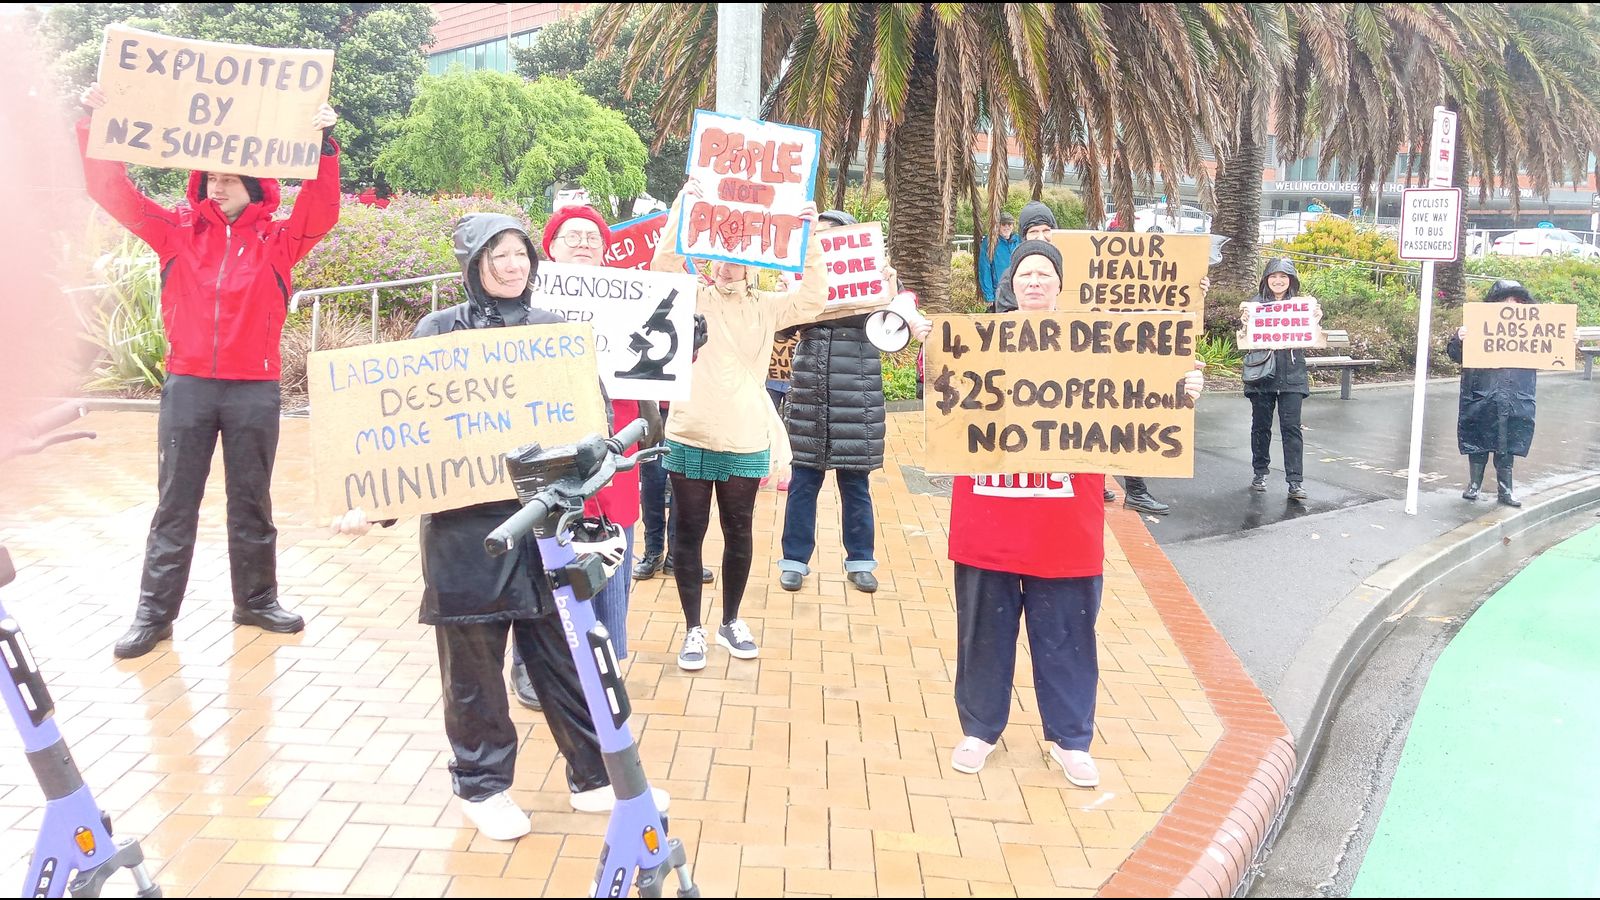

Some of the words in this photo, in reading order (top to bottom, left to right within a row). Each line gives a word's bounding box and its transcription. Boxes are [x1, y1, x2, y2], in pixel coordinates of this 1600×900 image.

[118, 39, 324, 91] EXPLOITED
[188, 92, 234, 126] BY
[105, 117, 153, 150] NZ
[698, 127, 804, 184] PEOPLE
[722, 179, 768, 203] NOT
[1275, 181, 1336, 192] WELLINGTON
[1412, 198, 1449, 208] CYCLISTS
[1411, 213, 1429, 222] GIVE
[1432, 213, 1448, 222] WAY
[687, 201, 804, 259] PROFIT
[1415, 226, 1424, 236] TO
[1427, 226, 1444, 236] BUS
[1089, 234, 1165, 258] YOUR
[1403, 240, 1453, 250] PASSENGERS
[1089, 258, 1177, 282] HEALTH
[1079, 283, 1191, 307] DESERVES
[1255, 303, 1309, 313] PEOPLE
[1500, 306, 1540, 321] OUR
[1254, 317, 1310, 328] BEFORE
[1483, 321, 1529, 338] LABS
[1531, 323, 1567, 339] ARE
[942, 320, 970, 359] 4
[974, 319, 1062, 352] YEAR
[1069, 319, 1194, 356] DEGREE
[1252, 332, 1313, 342] PROFITS
[1483, 338, 1552, 353] BROKEN
[329, 346, 471, 392] LABORATORY
[481, 335, 586, 365] WORKERS
[380, 373, 518, 417] DESERVE
[1064, 377, 1120, 409] PER
[355, 420, 432, 455] MORE
[444, 409, 512, 440] THAN
[524, 400, 576, 427] THE
[967, 421, 1028, 453] NO
[1032, 419, 1183, 458] THANKS
